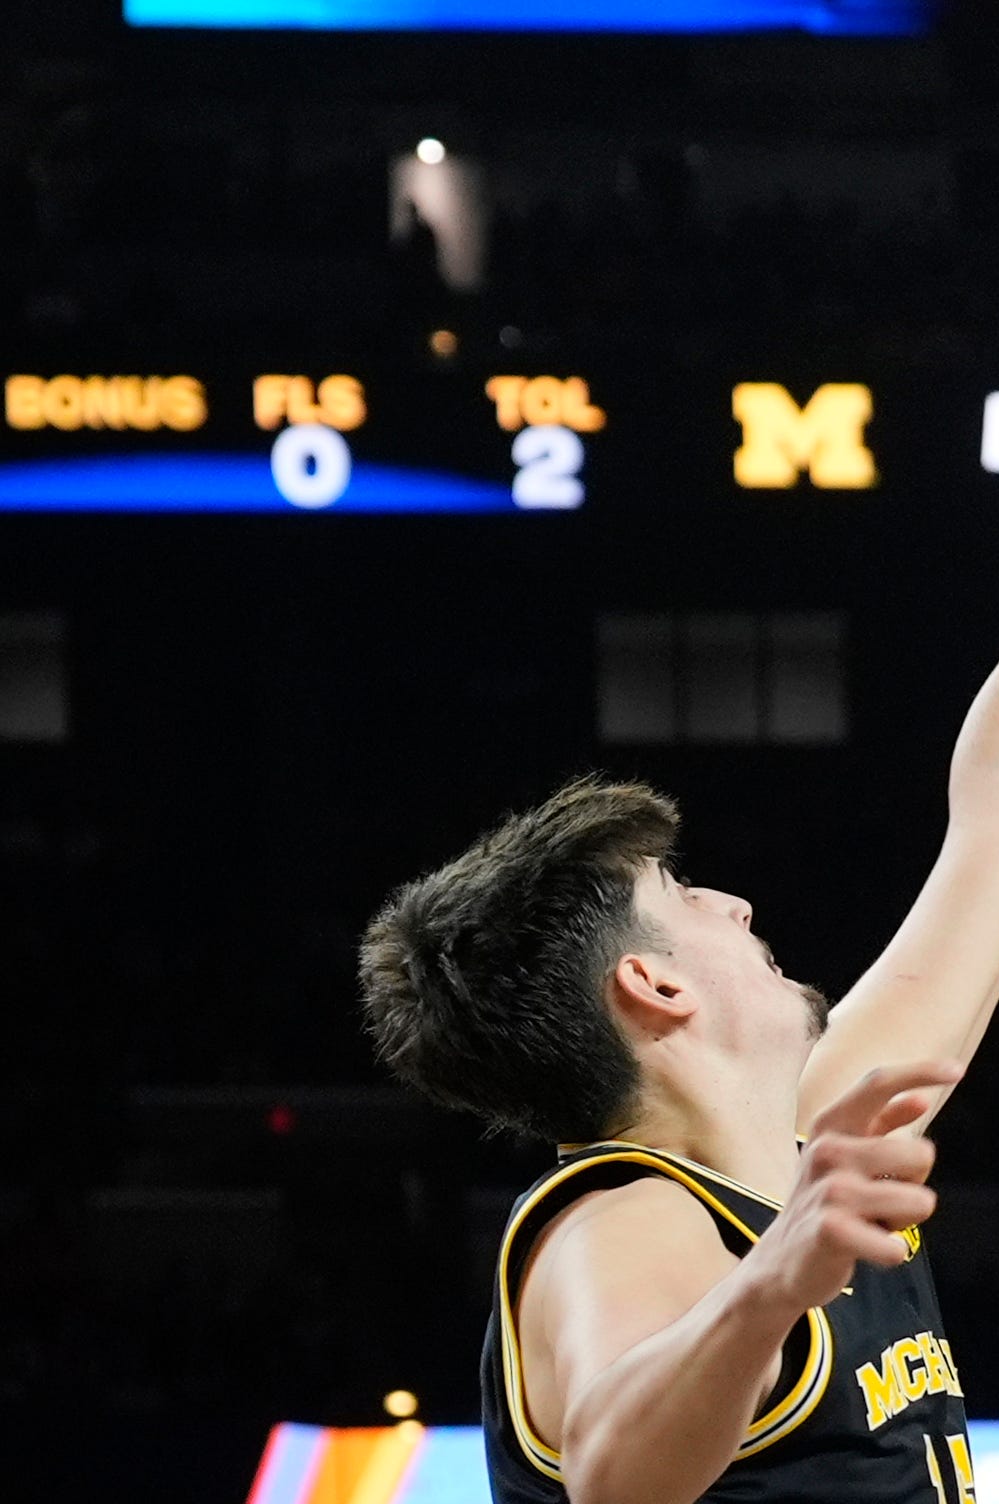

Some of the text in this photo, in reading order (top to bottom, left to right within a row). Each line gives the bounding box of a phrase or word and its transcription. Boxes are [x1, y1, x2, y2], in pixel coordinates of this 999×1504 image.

[5, 375, 206, 430] BONUS
[253, 375, 366, 431] FLS
[486, 376, 605, 432] TOL
[732, 383, 876, 489] M
[272, 423, 350, 508] 0
[512, 424, 584, 508] 2
